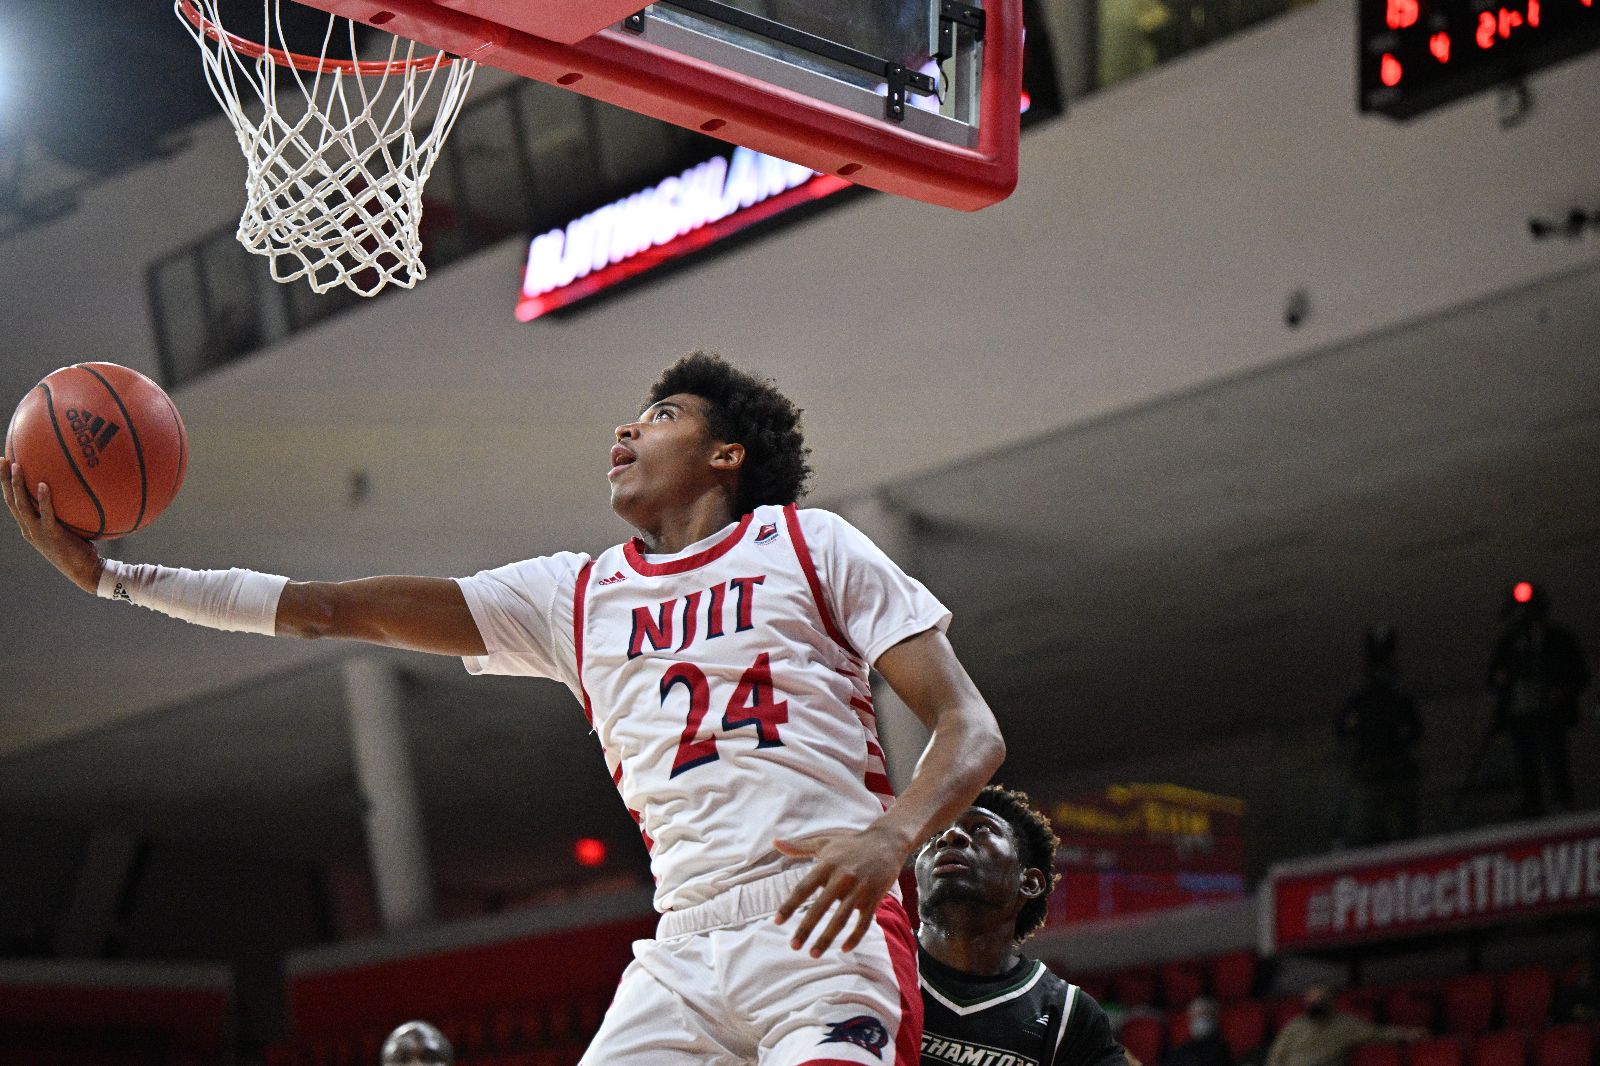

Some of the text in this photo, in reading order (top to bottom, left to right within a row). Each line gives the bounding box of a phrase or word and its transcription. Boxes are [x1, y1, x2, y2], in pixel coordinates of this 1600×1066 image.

[66, 408, 99, 468] adidas
[627, 575, 766, 659] NJIT
[660, 652, 789, 780] 24
